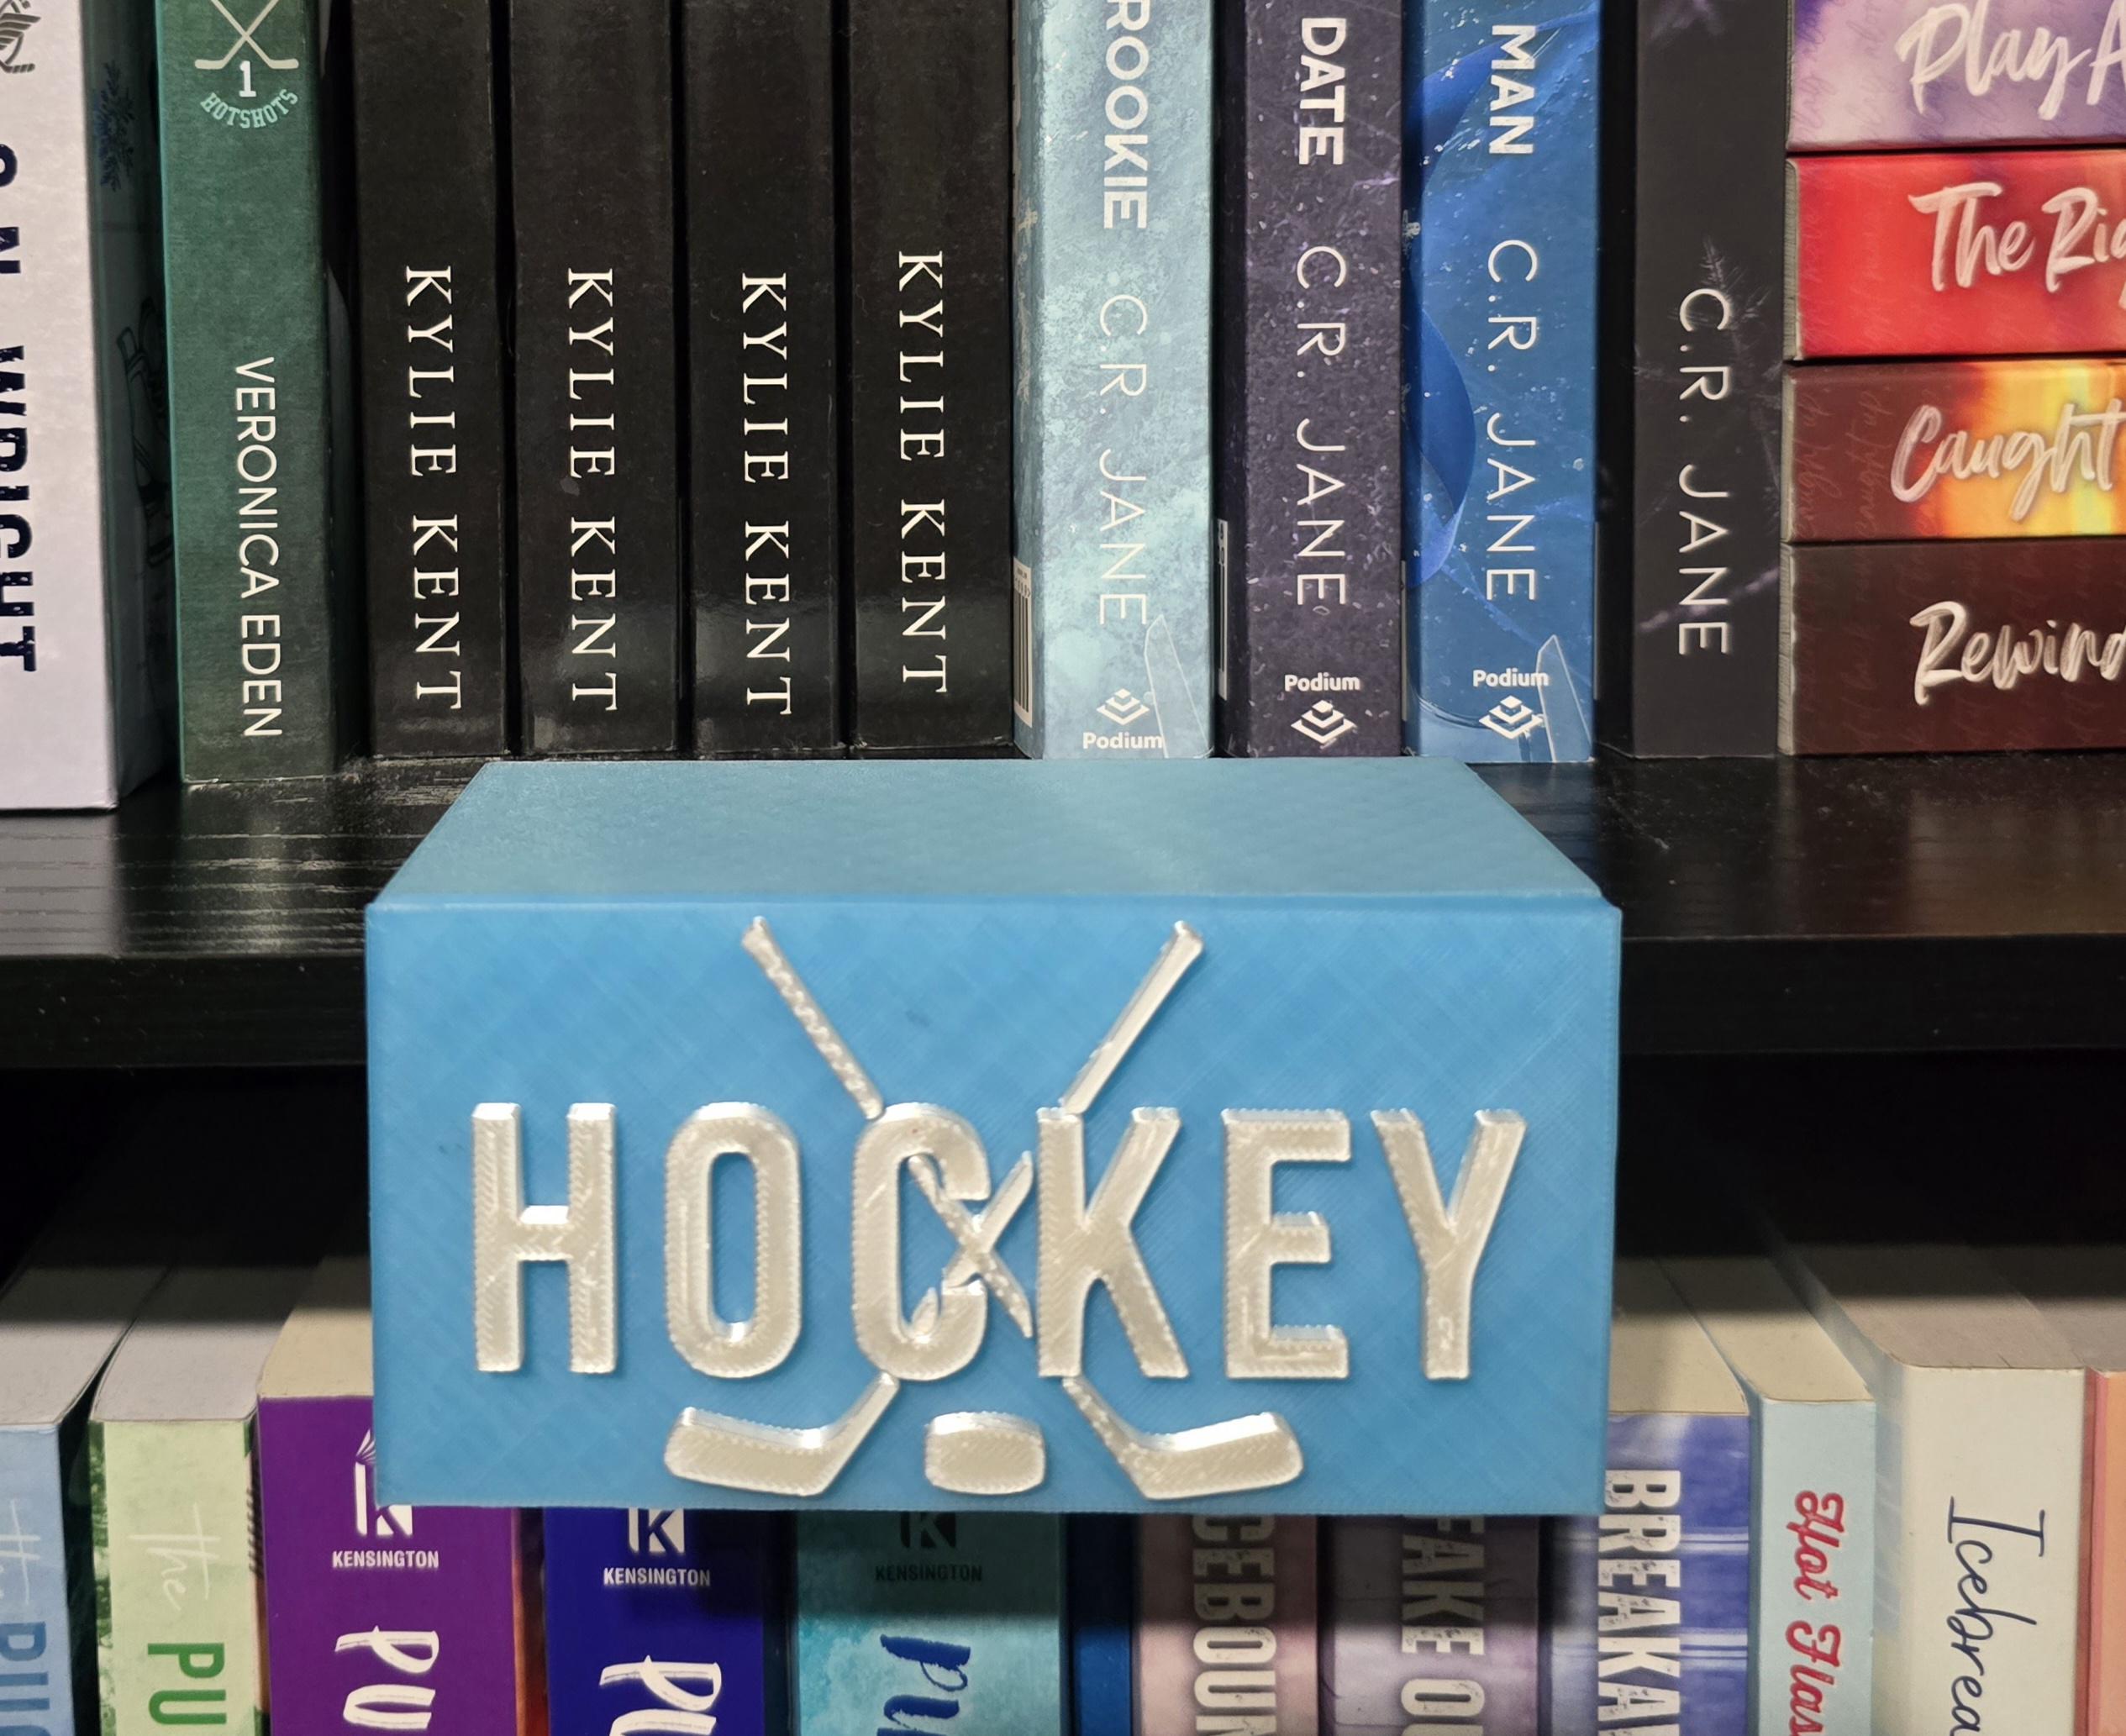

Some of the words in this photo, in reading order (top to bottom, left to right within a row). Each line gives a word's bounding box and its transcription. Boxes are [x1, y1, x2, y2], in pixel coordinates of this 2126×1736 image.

[200, 88, 299, 129] HOTSHOTS
[239, 60, 256, 97] 1
[1298, 18, 1346, 165] DATE
[1488, 24, 1536, 154] MAN
[1894, 0, 2092, 120] Play
[1908, 181, 2035, 292] The
[405, 265, 457, 478] KYLIE
[898, 250, 945, 460] KYLIE
[1099, 294, 1148, 414] C.R.
[1297, 245, 1346, 378] C.R.
[1487, 239, 1538, 372] C.R.
[1680, 288, 1731, 422] C.R.
[567, 268, 615, 479] KYLIE
[742, 272, 789, 483] KYLIE
[234, 356, 279, 599] VERONICA
[1297, 418, 1345, 605] JANE
[1487, 413, 1536, 600] JANE
[1891, 398, 2126, 522] Caught
[901, 498, 948, 693] KENT
[1099, 449, 1146, 625] JANE
[1679, 464, 1730, 655] JANE
[241, 614, 283, 737] EDEN
[412, 514, 463, 710] KENT
[571, 516, 618, 711] KENT
[745, 520, 792, 715] KENT
[1472, 669, 1550, 687] Podium
[1082, 732, 1163, 750] Podium
[1285, 672, 1361, 692] Podium
[471, 1101, 1527, 1382] HOCKEY
[332, 1549, 439, 1568] KENSINGTON
[603, 1567, 711, 1587] KENSINGTON
[875, 1564, 982, 1583] KENSINGTON
[1786, 1490, 1845, 1601] Hot
[147, 1643, 228, 1726] PU
[334, 1625, 439, 1730] PU
